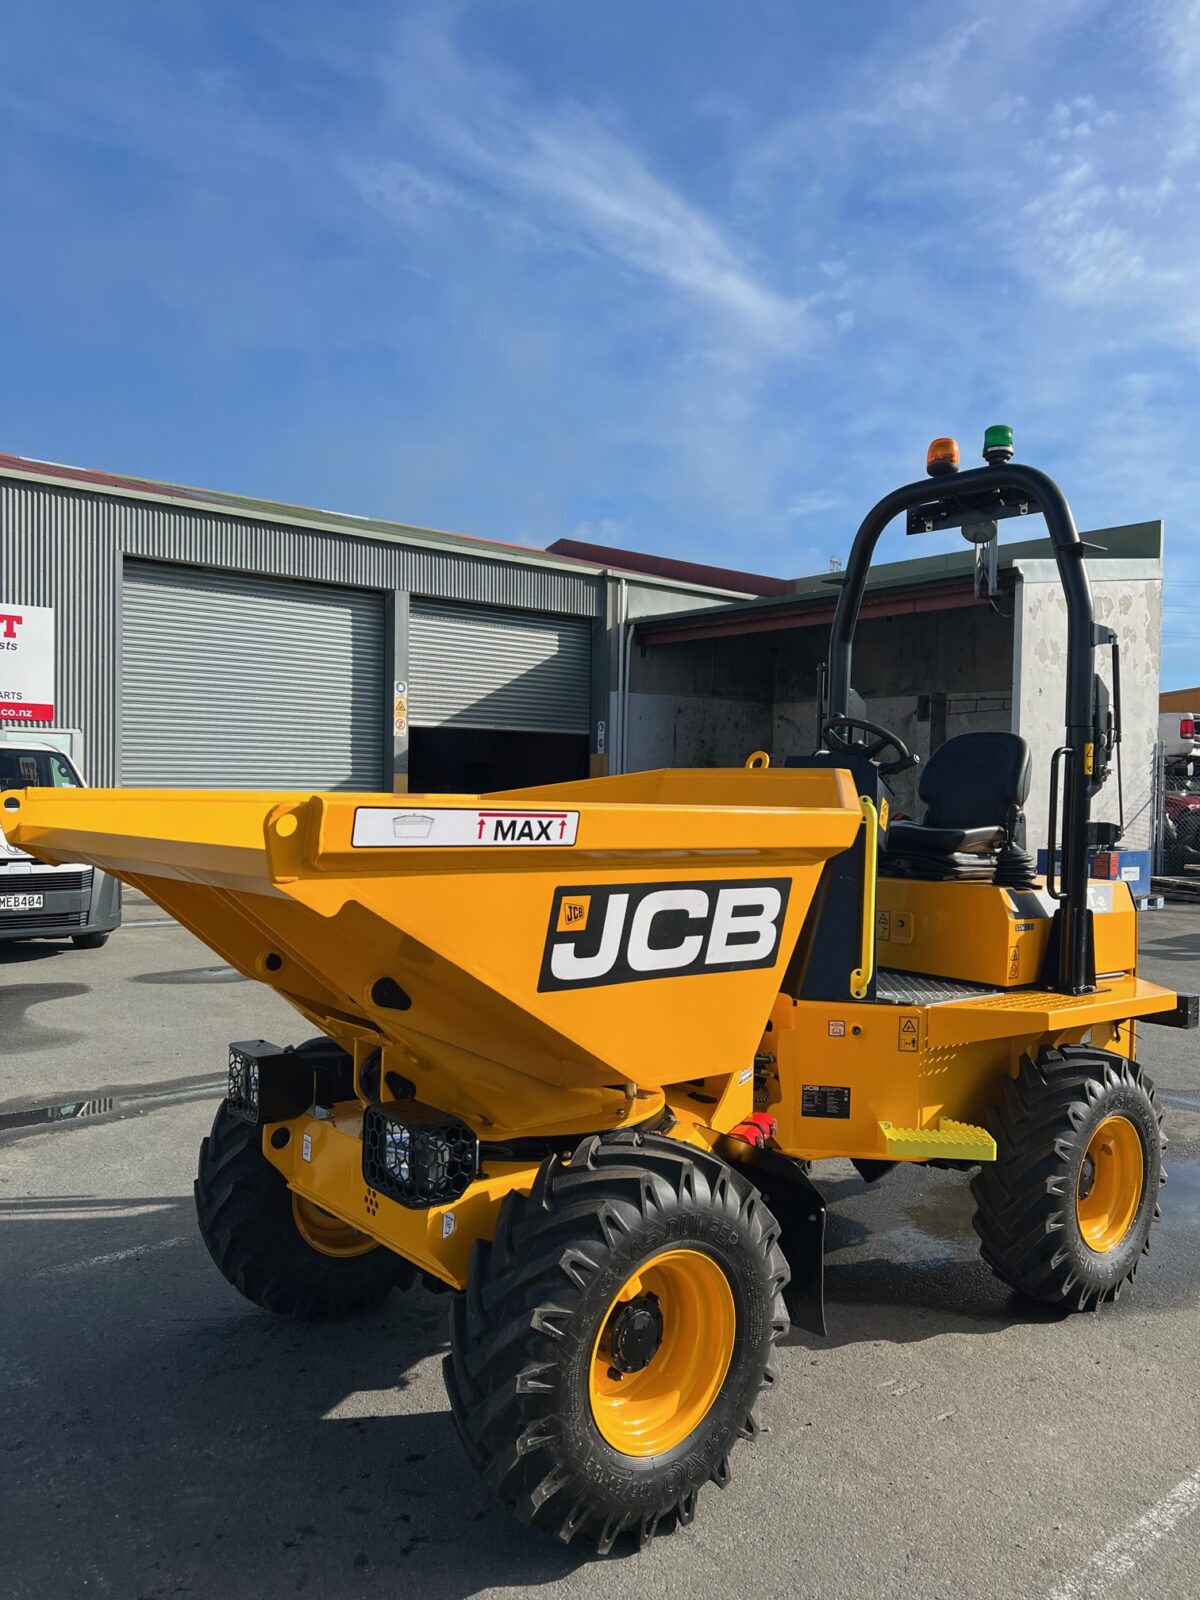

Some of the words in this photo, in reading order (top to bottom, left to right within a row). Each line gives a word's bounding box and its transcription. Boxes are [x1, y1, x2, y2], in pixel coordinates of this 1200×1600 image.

[493, 820, 553, 841] MAX
[567, 905, 583, 922] JCB
[551, 886, 782, 981] JCB
